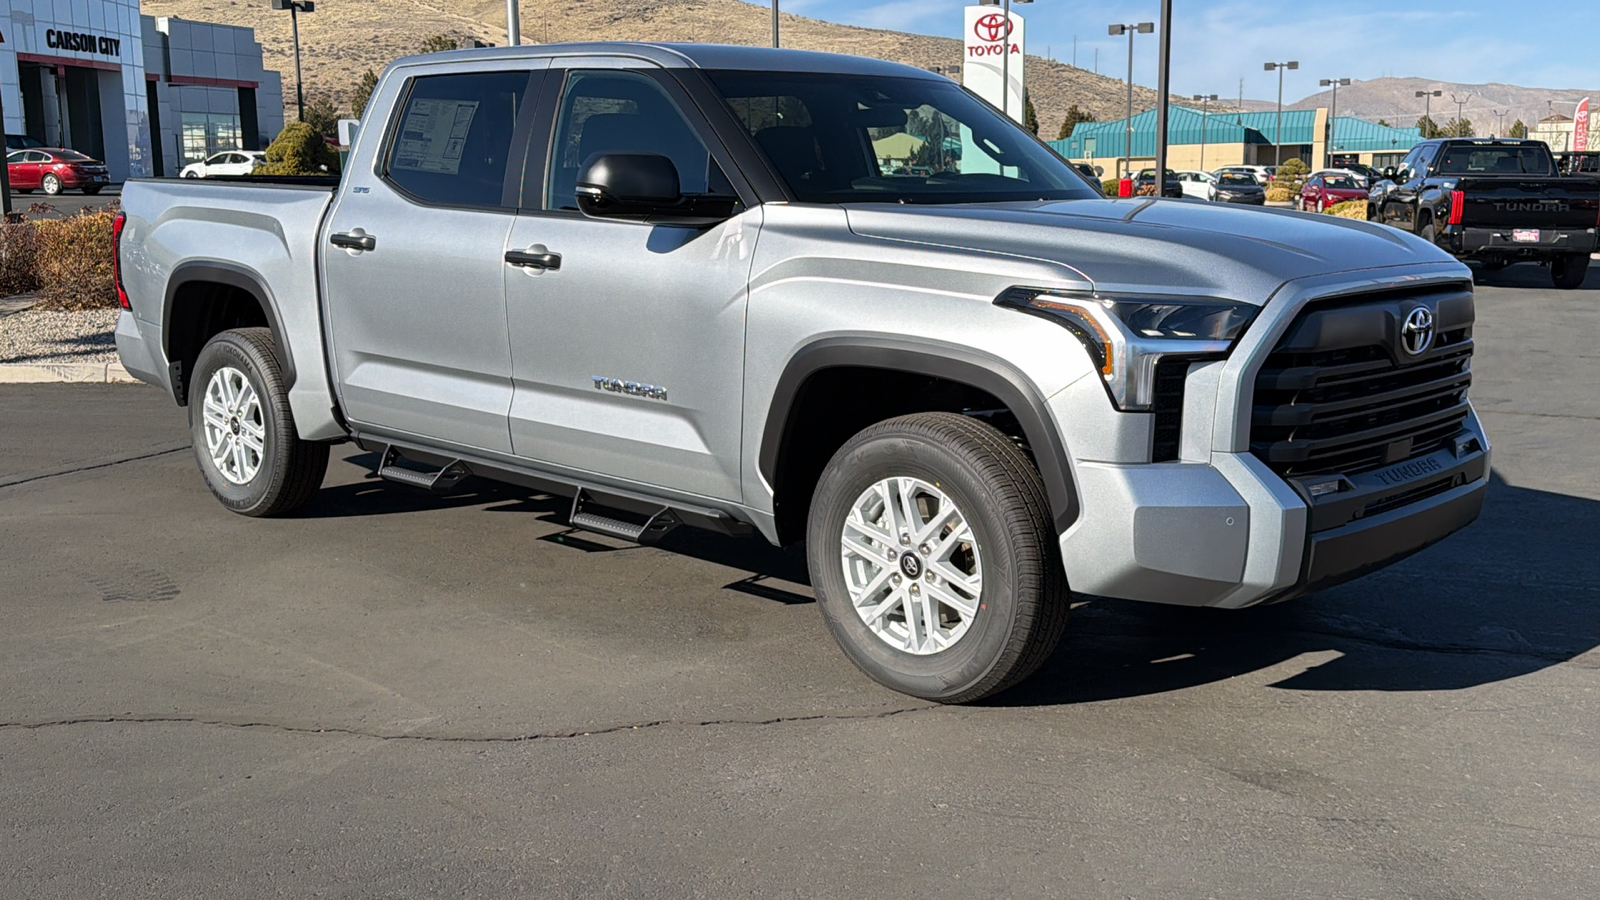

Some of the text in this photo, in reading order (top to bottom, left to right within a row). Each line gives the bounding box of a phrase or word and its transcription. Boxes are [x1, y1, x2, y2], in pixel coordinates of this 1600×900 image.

[46, 28, 120, 57] CARSON CITY
[1493, 202, 1570, 212] TUNDRA
[591, 375, 667, 401] TUNDRA
[1374, 456, 1442, 485] TUNDRA
